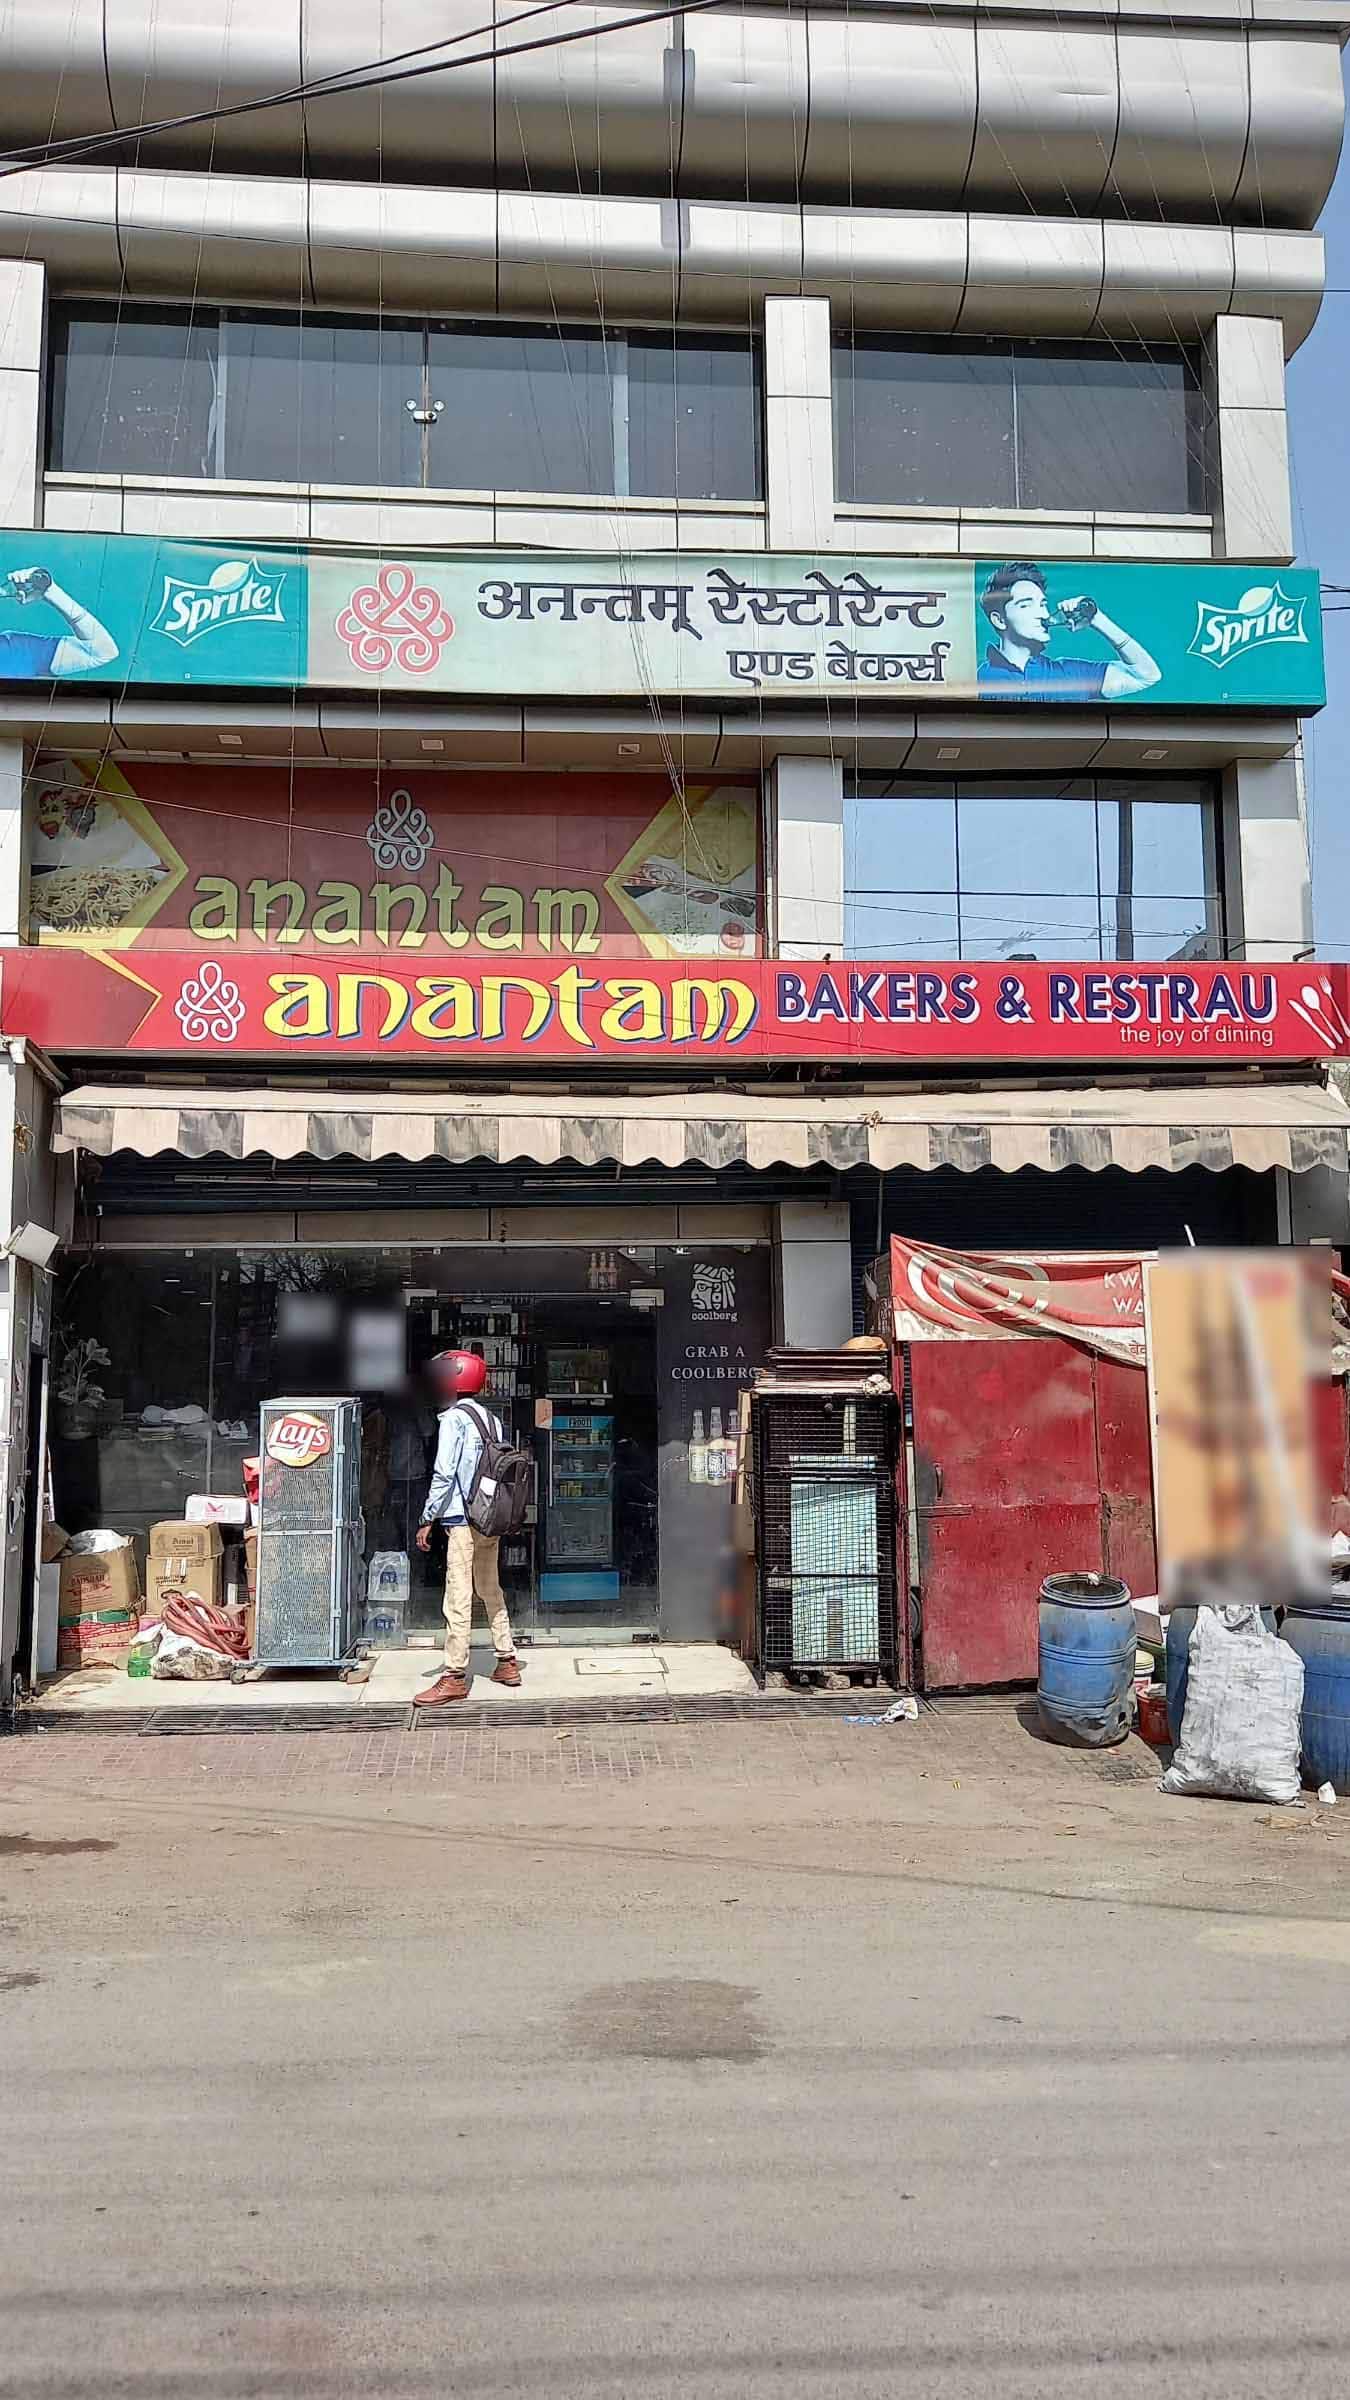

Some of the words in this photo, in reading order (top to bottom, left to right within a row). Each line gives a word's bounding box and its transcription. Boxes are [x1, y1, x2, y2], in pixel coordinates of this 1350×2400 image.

[165, 573, 272, 635] Sprite
[1200, 597, 1296, 657] Sprite
[726, 650, 816, 688] एण्ड
[825, 640, 951, 682] बेकर्स
[189, 862, 602, 954] anantam
[263, 964, 758, 1049] anantam
[776, 972, 981, 1024] BAKERS
[996, 974, 1034, 1024] &
[1049, 973, 1278, 1024] RESTRAU
[1120, 1026, 1150, 1043] the
[1156, 1026, 1185, 1047] joy
[1191, 1025, 1209, 1043] of
[1215, 1025, 1274, 1047] dining
[691, 1311, 738, 1322] coolberg
[685, 1346, 729, 1358] GRAB
[735, 1346, 745, 1358] A
